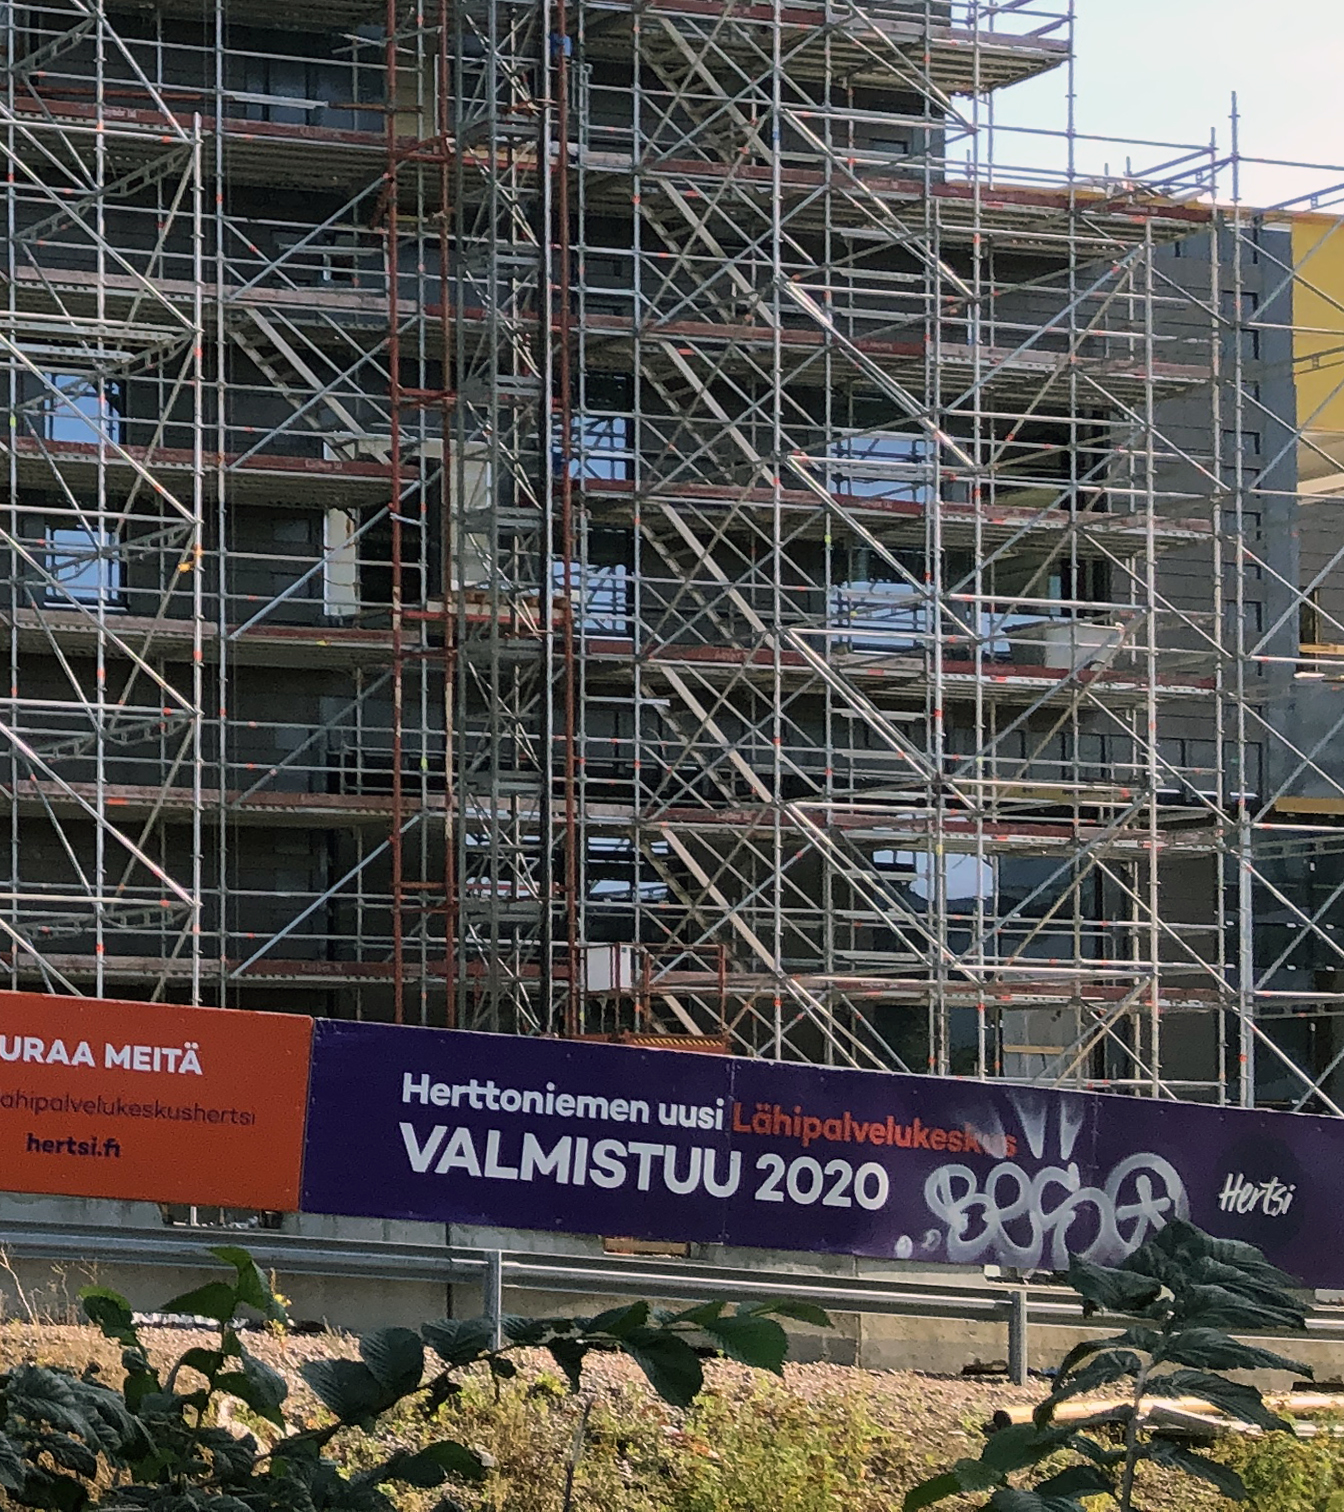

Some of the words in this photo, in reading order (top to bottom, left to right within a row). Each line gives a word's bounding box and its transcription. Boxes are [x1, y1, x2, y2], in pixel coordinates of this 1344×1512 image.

[105, 1042, 203, 1075] MEITÄ
[402, 1072, 650, 1124] Herttoniemen
[659, 1098, 725, 1130] uusi
[27, 1133, 121, 1157] hertsi.fi
[399, 1122, 742, 1198] VALMISTUU
[755, 1153, 890, 1210] 2020
[1219, 1173, 1297, 1217] Hertsi
